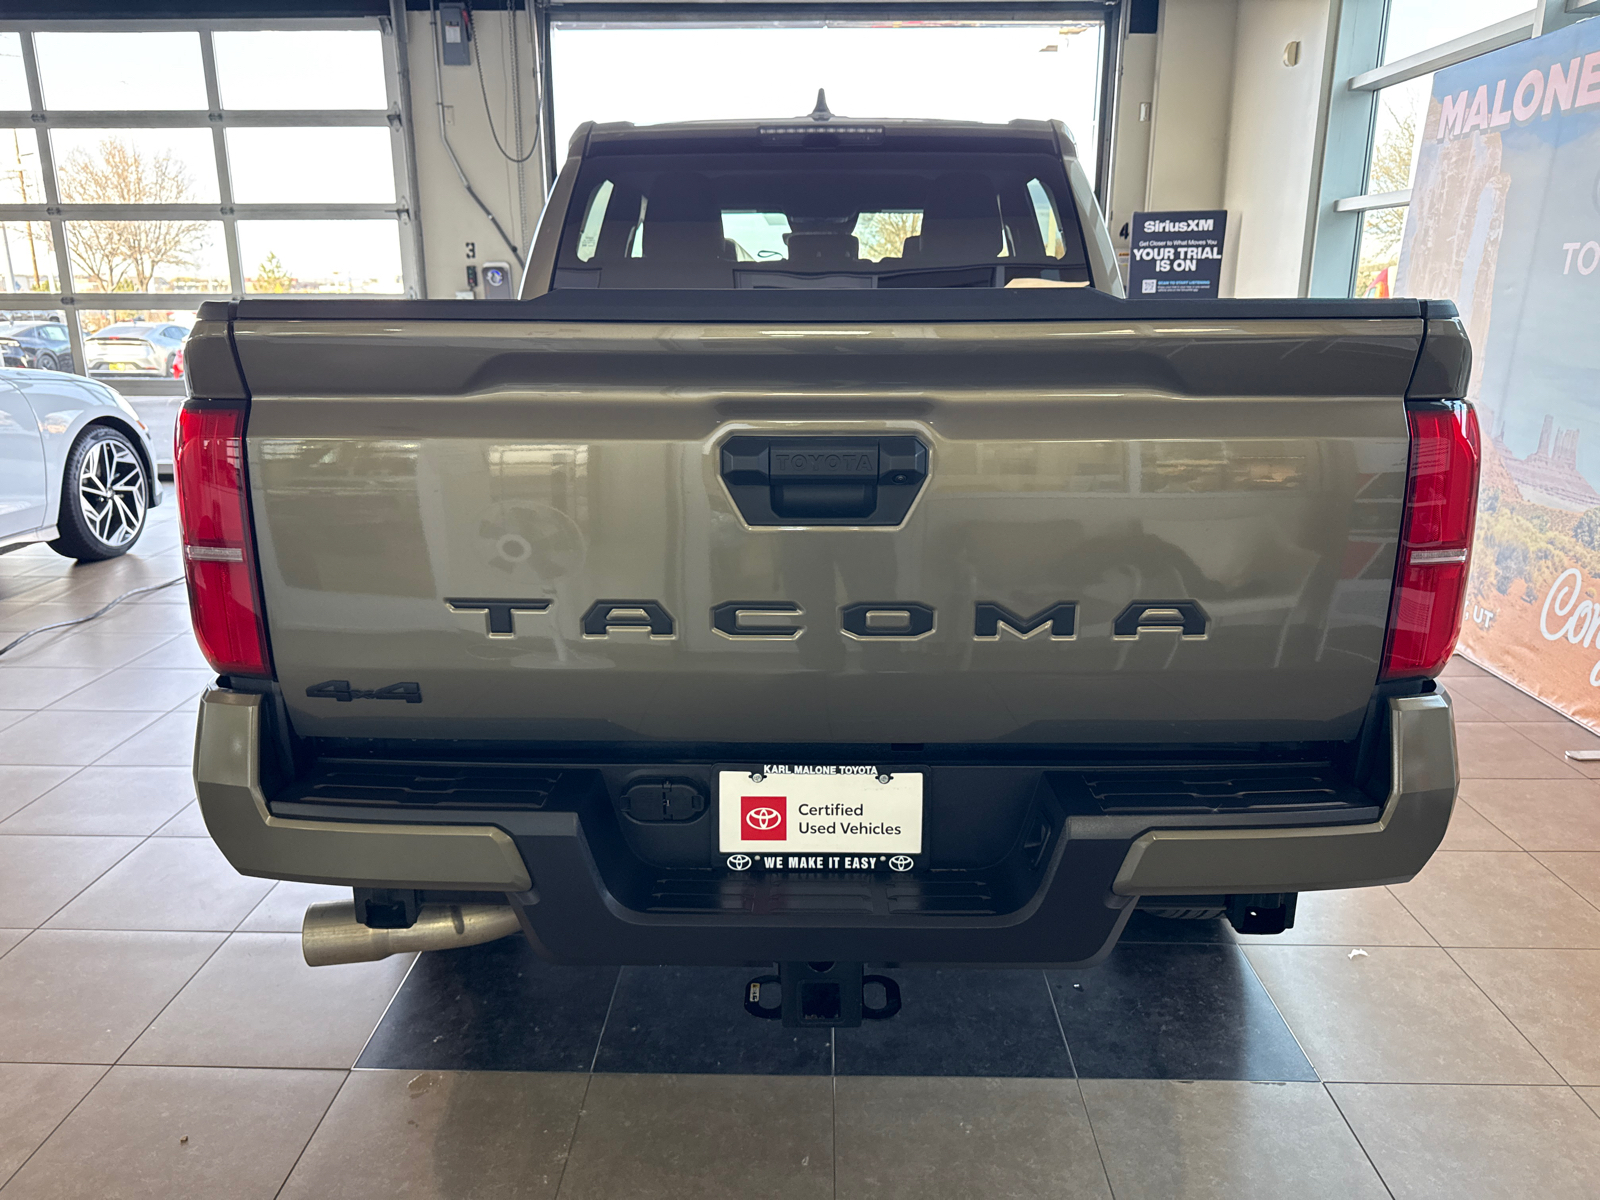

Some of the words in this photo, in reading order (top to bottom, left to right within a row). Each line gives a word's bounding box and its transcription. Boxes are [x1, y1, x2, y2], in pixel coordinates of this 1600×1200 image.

[1437, 51, 1600, 140] MALONE
[1119, 222, 1129, 240] 4
[1144, 219, 1214, 233] SiriusXM
[466, 242, 476, 259] 3
[1133, 248, 1175, 261] YOUR
[1177, 247, 1222, 260] TRIAL
[1156, 260, 1171, 272] IS
[1173, 259, 1197, 272] ON
[1563, 241, 1600, 276] TO
[775, 454, 873, 472] TOYOTA
[444, 598, 1211, 641] TACOMA
[1473, 604, 1494, 628] UT
[763, 765, 792, 775] KARL
[794, 765, 837, 775] MALONE
[838, 765, 878, 775] TOYOTA
[798, 803, 864, 817] Certified
[798, 822, 836, 835] Used
[840, 822, 902, 836] Vehicles
[764, 857, 783, 869] WE
[788, 857, 823, 869] MAKE
[828, 857, 840, 869] IT
[844, 857, 877, 870] EASY
